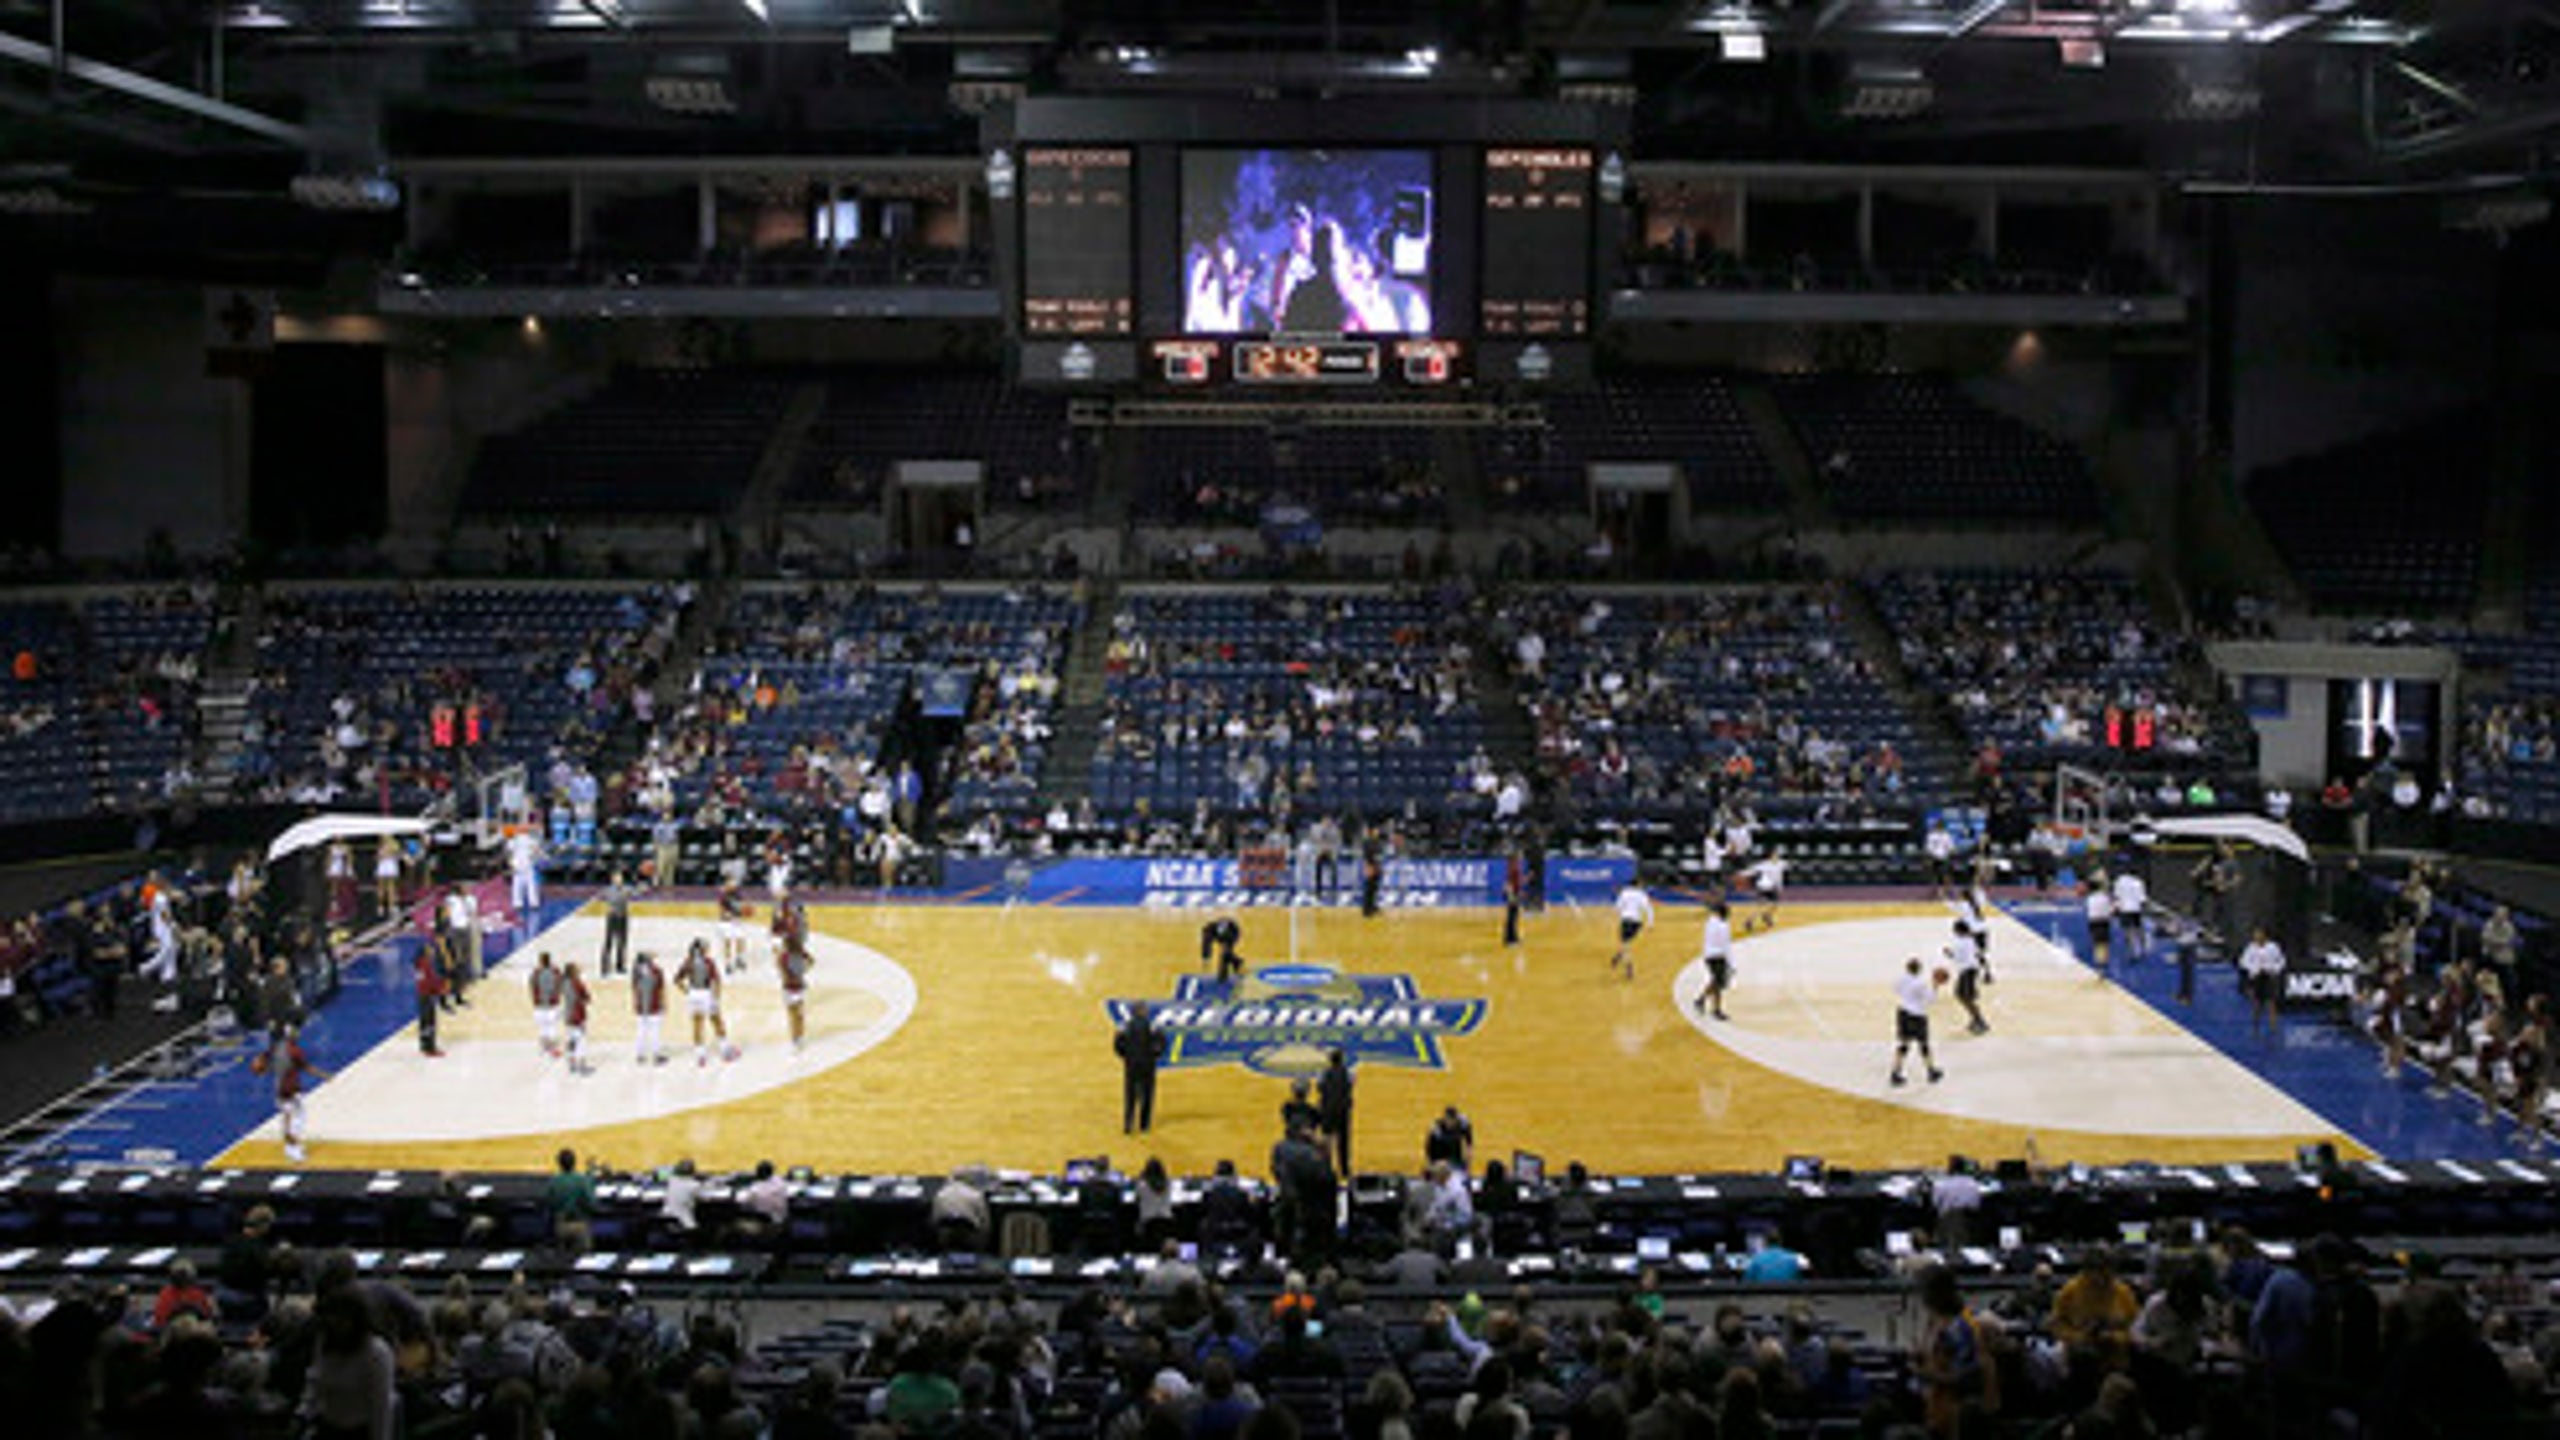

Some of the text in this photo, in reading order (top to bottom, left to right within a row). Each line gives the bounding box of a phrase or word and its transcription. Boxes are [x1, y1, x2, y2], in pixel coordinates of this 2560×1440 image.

[1145, 860, 1214, 887] NCAA
[2284, 973, 2356, 999] NCAA
[1152, 1007, 1444, 1028] REGIONAL
